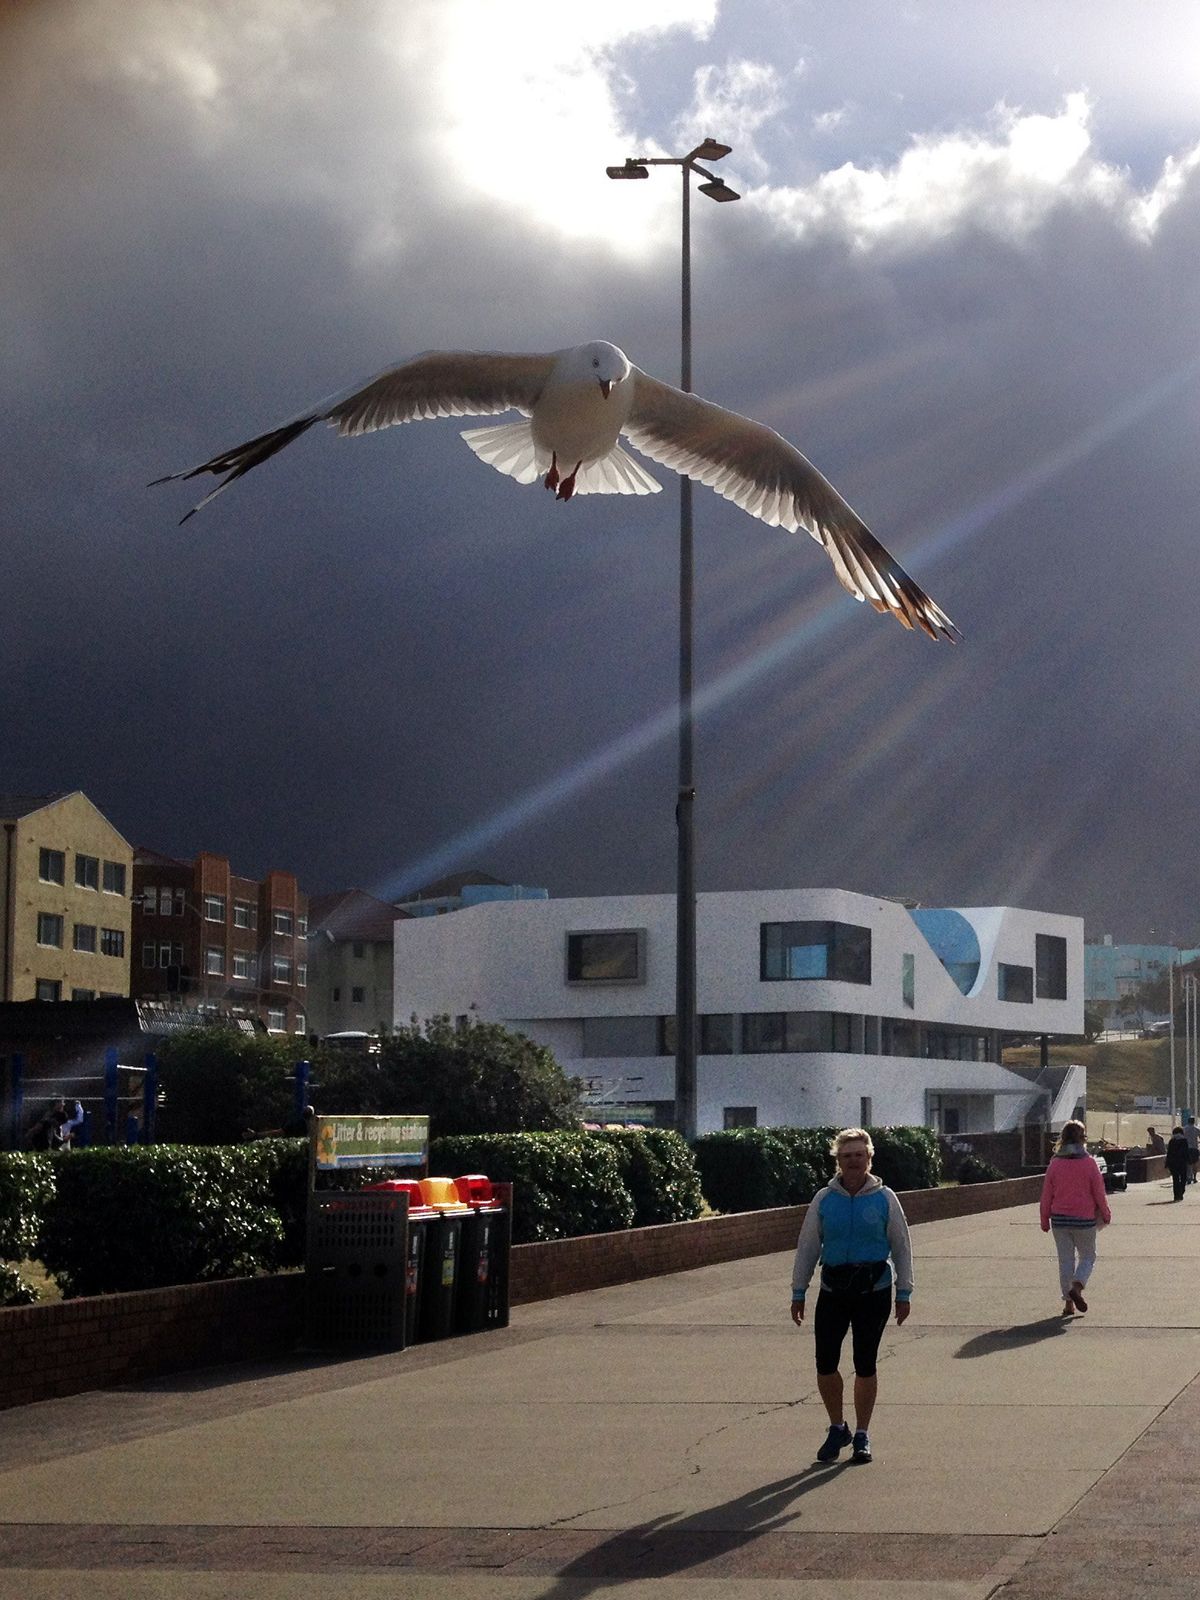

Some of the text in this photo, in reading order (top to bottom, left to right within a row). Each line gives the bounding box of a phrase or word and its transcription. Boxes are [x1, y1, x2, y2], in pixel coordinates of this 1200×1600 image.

[333, 1122, 428, 1144] Litter & recycling station
